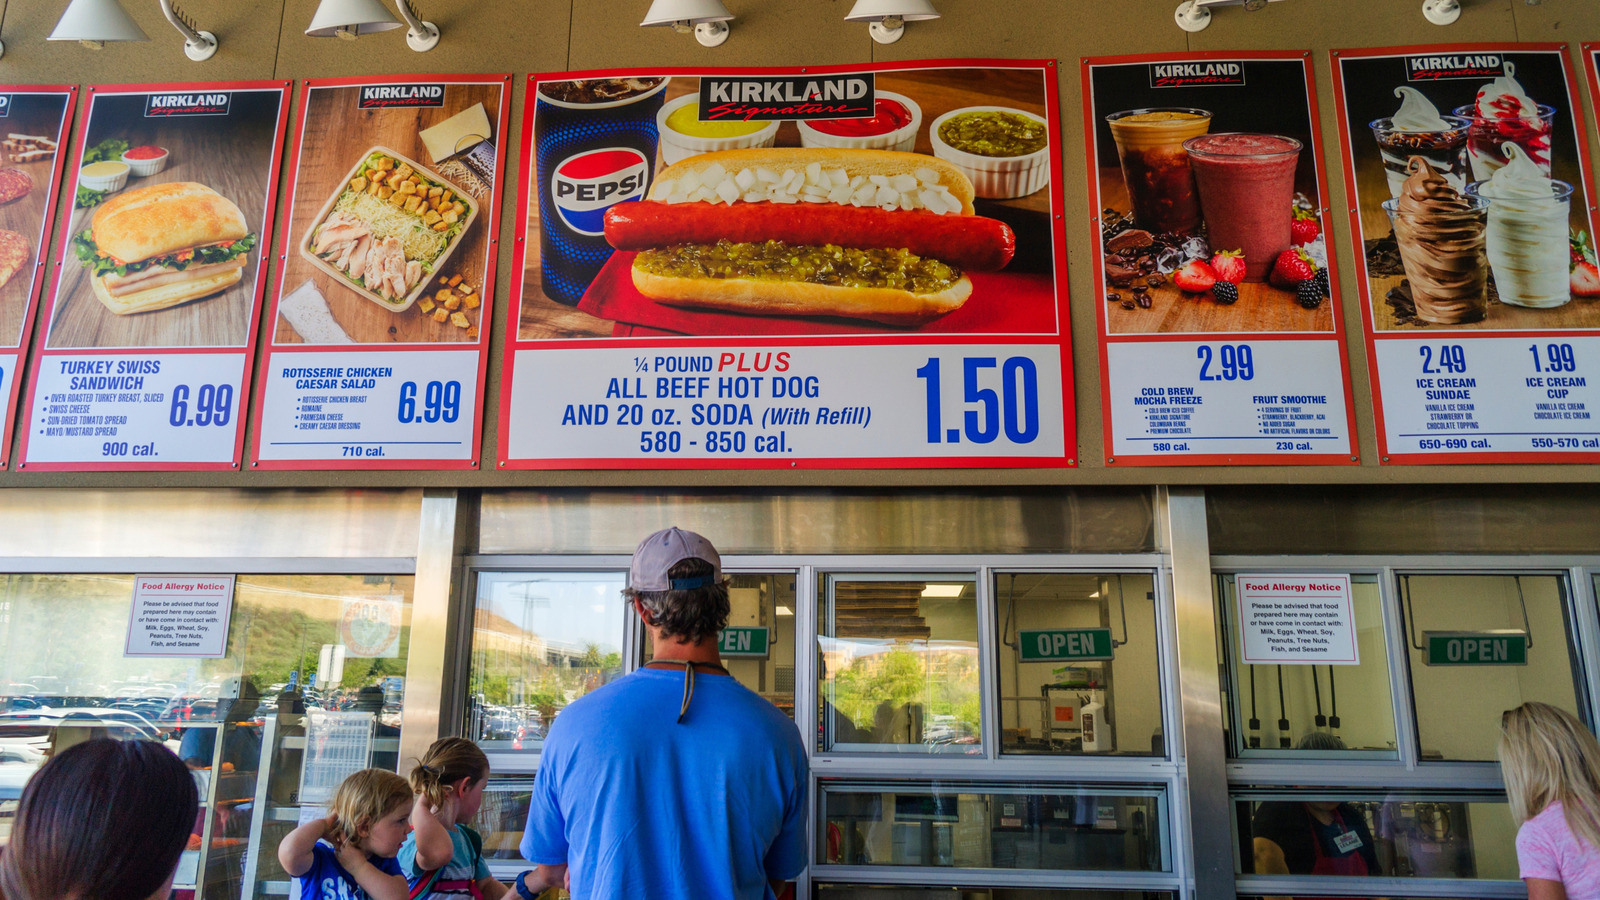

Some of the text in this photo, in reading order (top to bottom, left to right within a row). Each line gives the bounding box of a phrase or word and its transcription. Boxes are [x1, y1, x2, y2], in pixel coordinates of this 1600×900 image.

[1411, 56, 1499, 70] KIRKLAND
[1155, 63, 1240, 77] KIRKLAND
[1413, 69, 1502, 80] Signature
[1156, 76, 1240, 87] Signature
[364, 86, 442, 99] KIRKLAND
[709, 78, 867, 102] KIRKLAND
[151, 94, 227, 108] KIRKLAND
[363, 98, 440, 109] Signature
[150, 107, 226, 117] Signature
[708, 102, 868, 121] Signature
[557, 170, 644, 202] PEPSI
[654, 356, 712, 372] POUND
[718, 352, 791, 372] PLUS
[1197, 345, 1254, 381] 2.99
[1420, 345, 1467, 374] 2.49
[1529, 344, 1576, 372] 1.99
[60, 361, 161, 374] TURKEY SWISS
[282, 367, 392, 377] ROTISSERIE CHICKEN
[70, 377, 144, 390] SANDWICH
[296, 379, 375, 389] CAESAR SALAD
[606, 376, 819, 398] ALL BEEF HOT DOG
[1416, 378, 1476, 388] ICE CREAM
[1526, 377, 1586, 387] ICE CREAM
[51, 394, 66, 402] OVEN
[67, 394, 94, 402] ROASTED
[95, 394, 117, 402] TURKEY
[144, 393, 164, 402] SLICED
[1141, 388, 1165, 396] COLD
[1426, 390, 1470, 400] SUNDAE
[1547, 389, 1569, 399] CUP
[169, 384, 233, 427] 6.99
[398, 381, 461, 424] 6.99
[916, 356, 1039, 444] 1.50
[1134, 397, 1167, 405] MOCHA
[1253, 396, 1327, 404] FRUIT SMOOTHIE
[49, 405, 90, 414] SWISS CHEESE
[79, 416, 104, 425] TOMATO
[104, 416, 127, 425] SPREAD
[561, 404, 872, 429] AND 20 oz. SODA (With Refill)
[94, 427, 118, 436] SPREAD
[640, 431, 680, 453] 580
[705, 431, 746, 453] 850
[754, 431, 793, 453] cal.
[1153, 443, 1190, 451] 580 cal.
[1276, 442, 1313, 450] 230 cal.
[1419, 438, 1491, 449] 650-690 cal.
[1532, 438, 1579, 448] 550-570
[102, 442, 158, 456] 900 cal.
[342, 446, 385, 457] 710 cal.
[165, 583, 194, 591] Allergy
[1272, 584, 1306, 592] Allergy
[1037, 633, 1095, 656] OPEN
[1447, 639, 1507, 661] OPEN
